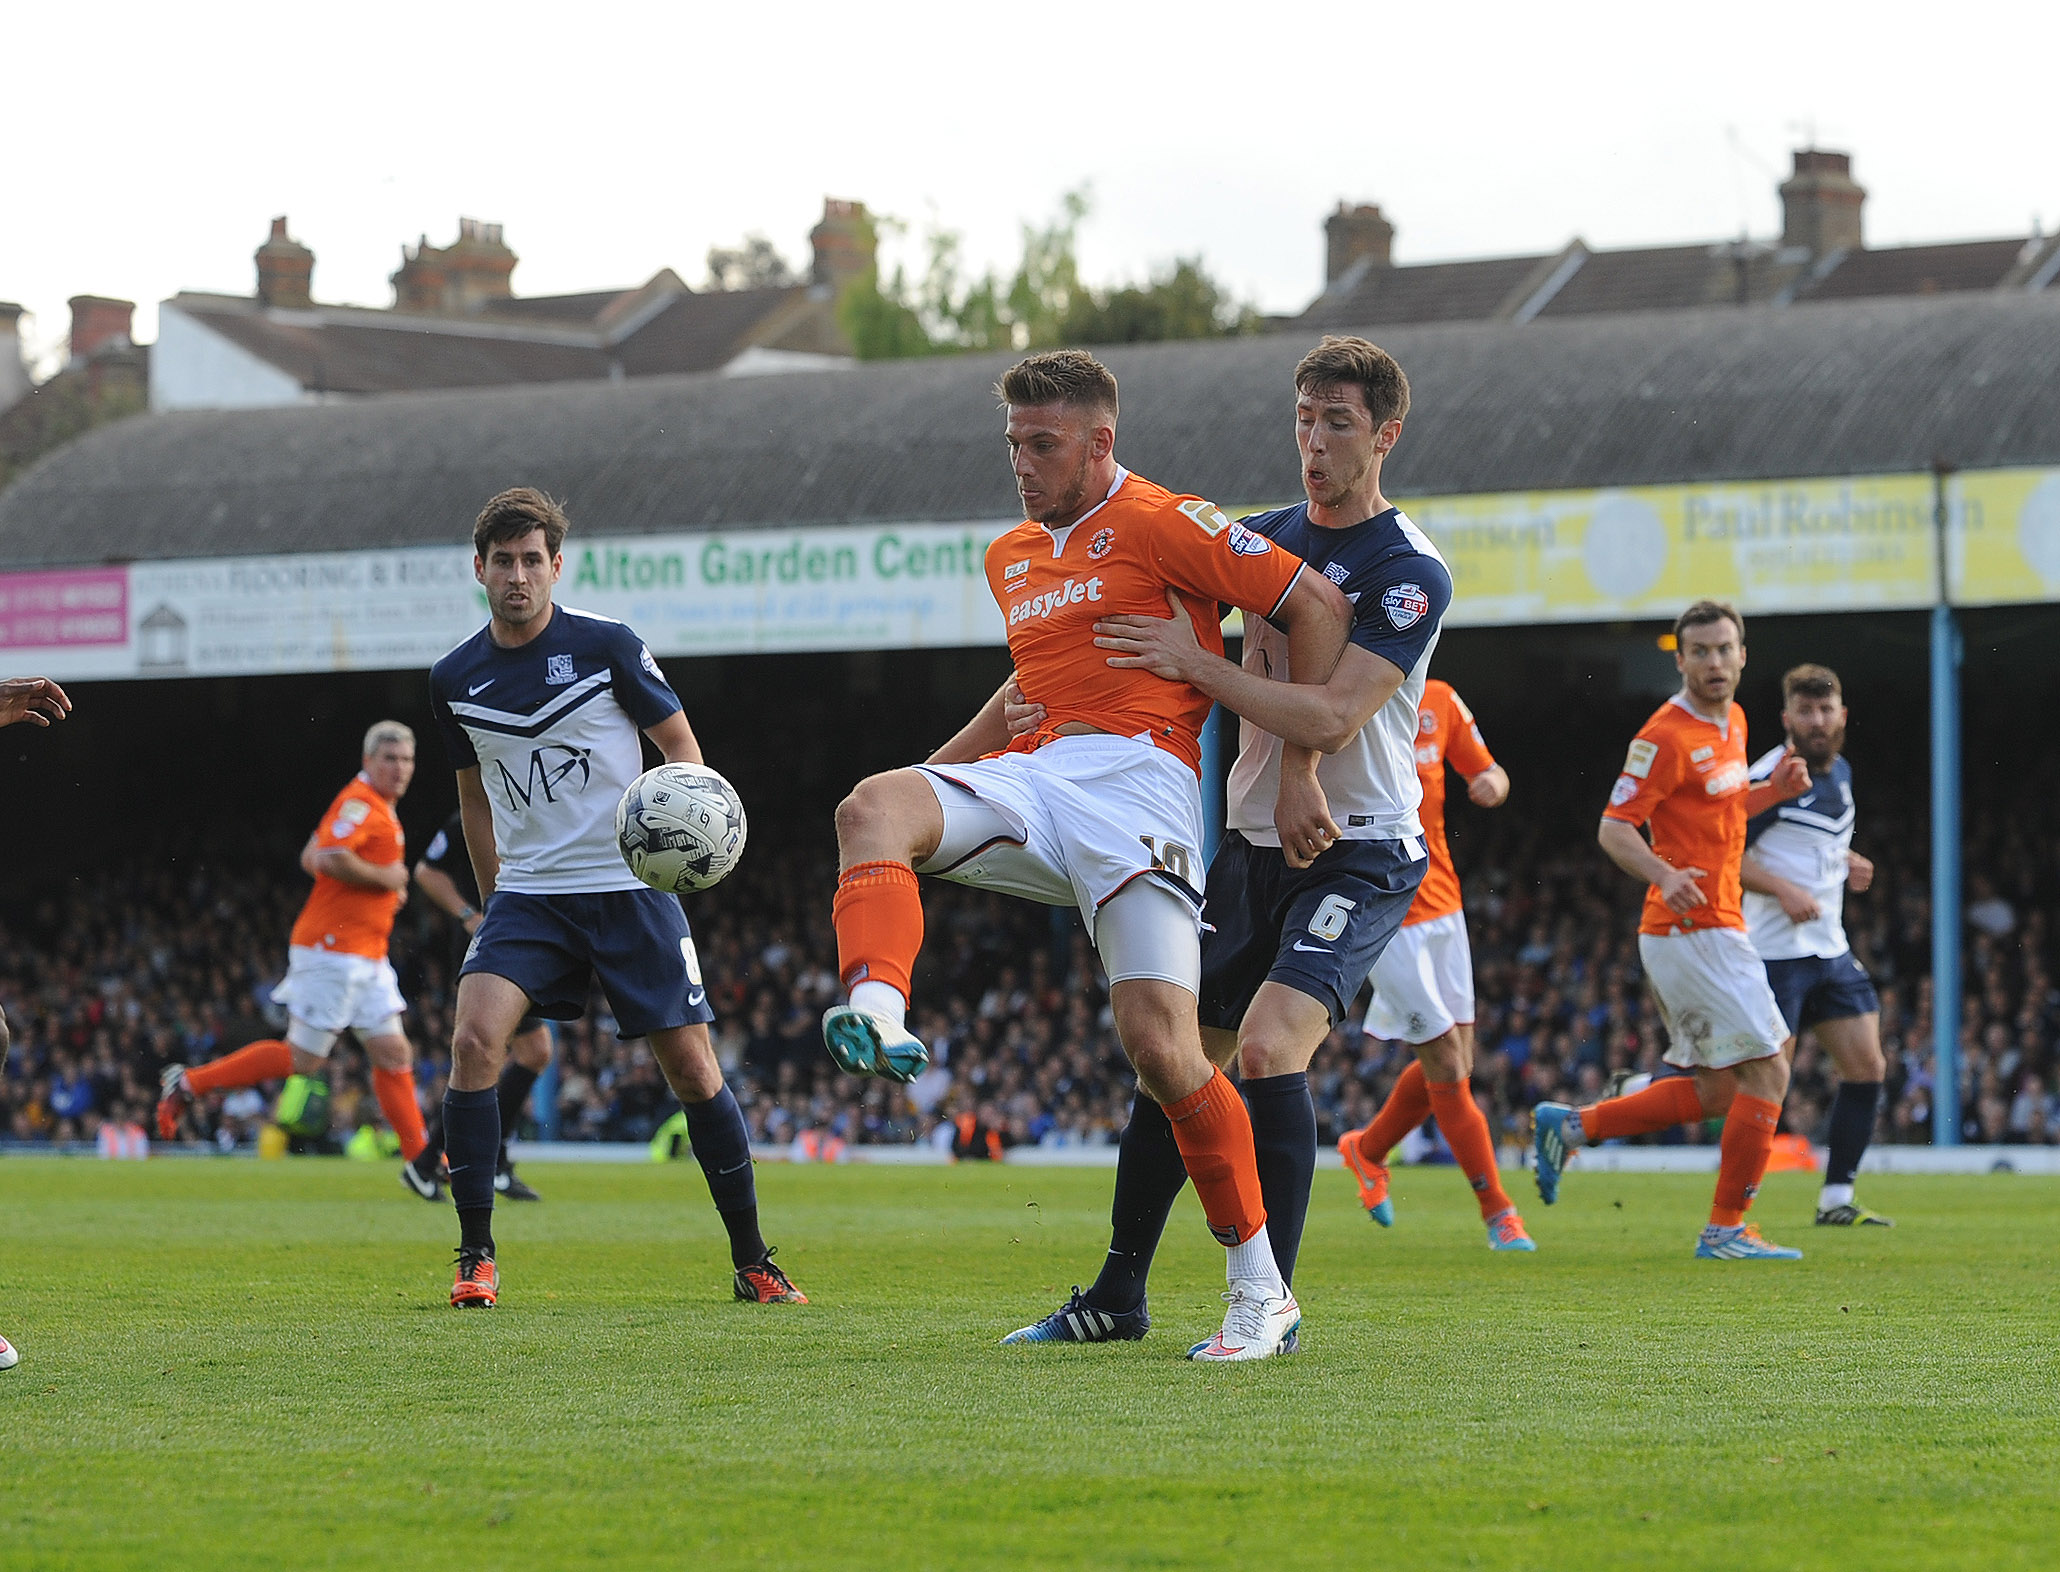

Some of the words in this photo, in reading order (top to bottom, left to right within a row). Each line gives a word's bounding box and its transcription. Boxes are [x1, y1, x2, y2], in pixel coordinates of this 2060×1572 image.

[1684, 491, 1773, 541] Paul
[1780, 486, 1984, 535] Robinsn
[574, 543, 684, 591] Alton
[701, 537, 857, 586] Garden
[1006, 561, 1028, 578] FILA
[1009, 576, 1103, 626] easyJet
[1385, 595, 1402, 607] sky
[1404, 599, 1425, 612] BET
[1308, 893, 1357, 941] 6
